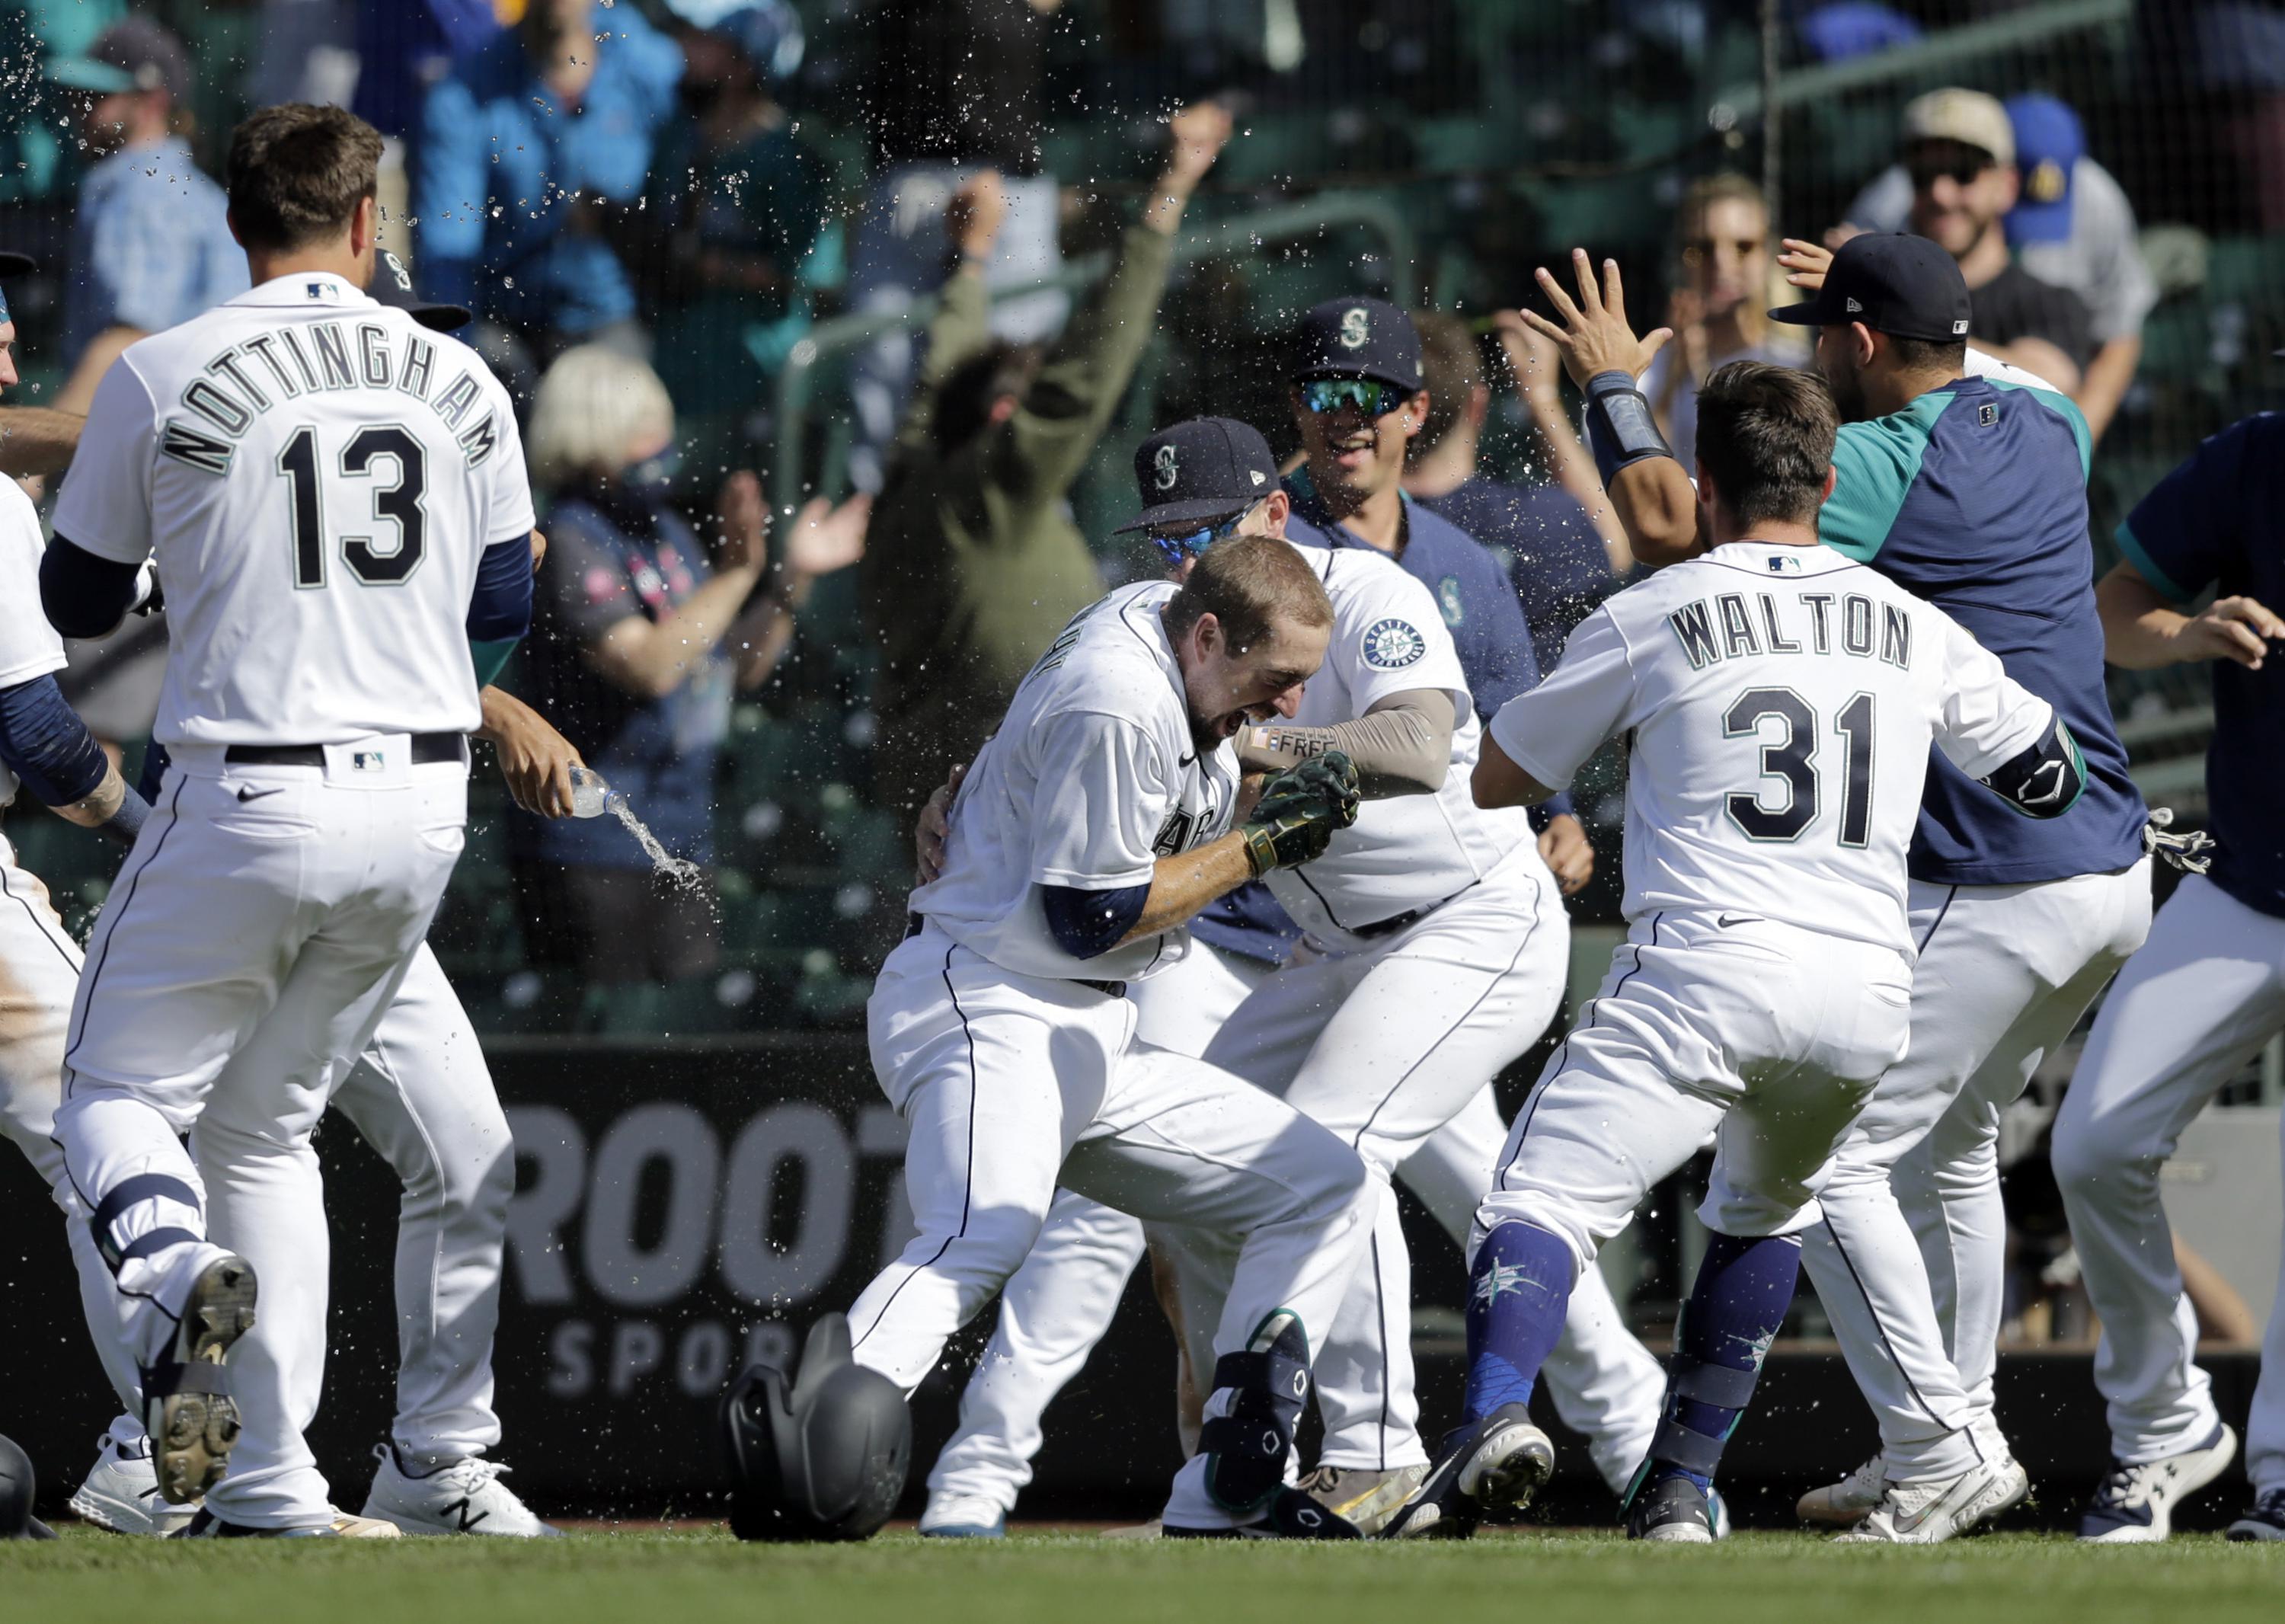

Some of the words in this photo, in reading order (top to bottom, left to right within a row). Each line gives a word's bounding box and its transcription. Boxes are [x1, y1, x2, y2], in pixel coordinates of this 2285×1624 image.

[161, 321, 498, 476] NOTTINGHAM
[276, 424, 427, 590] 13
[1366, 619, 1419, 644] SEATTLE
[1370, 644, 1424, 667] MARINERS
[1667, 592, 1913, 672] WALTON
[1721, 686, 1876, 849] 31
[548, 1319, 794, 1399] SPOR
